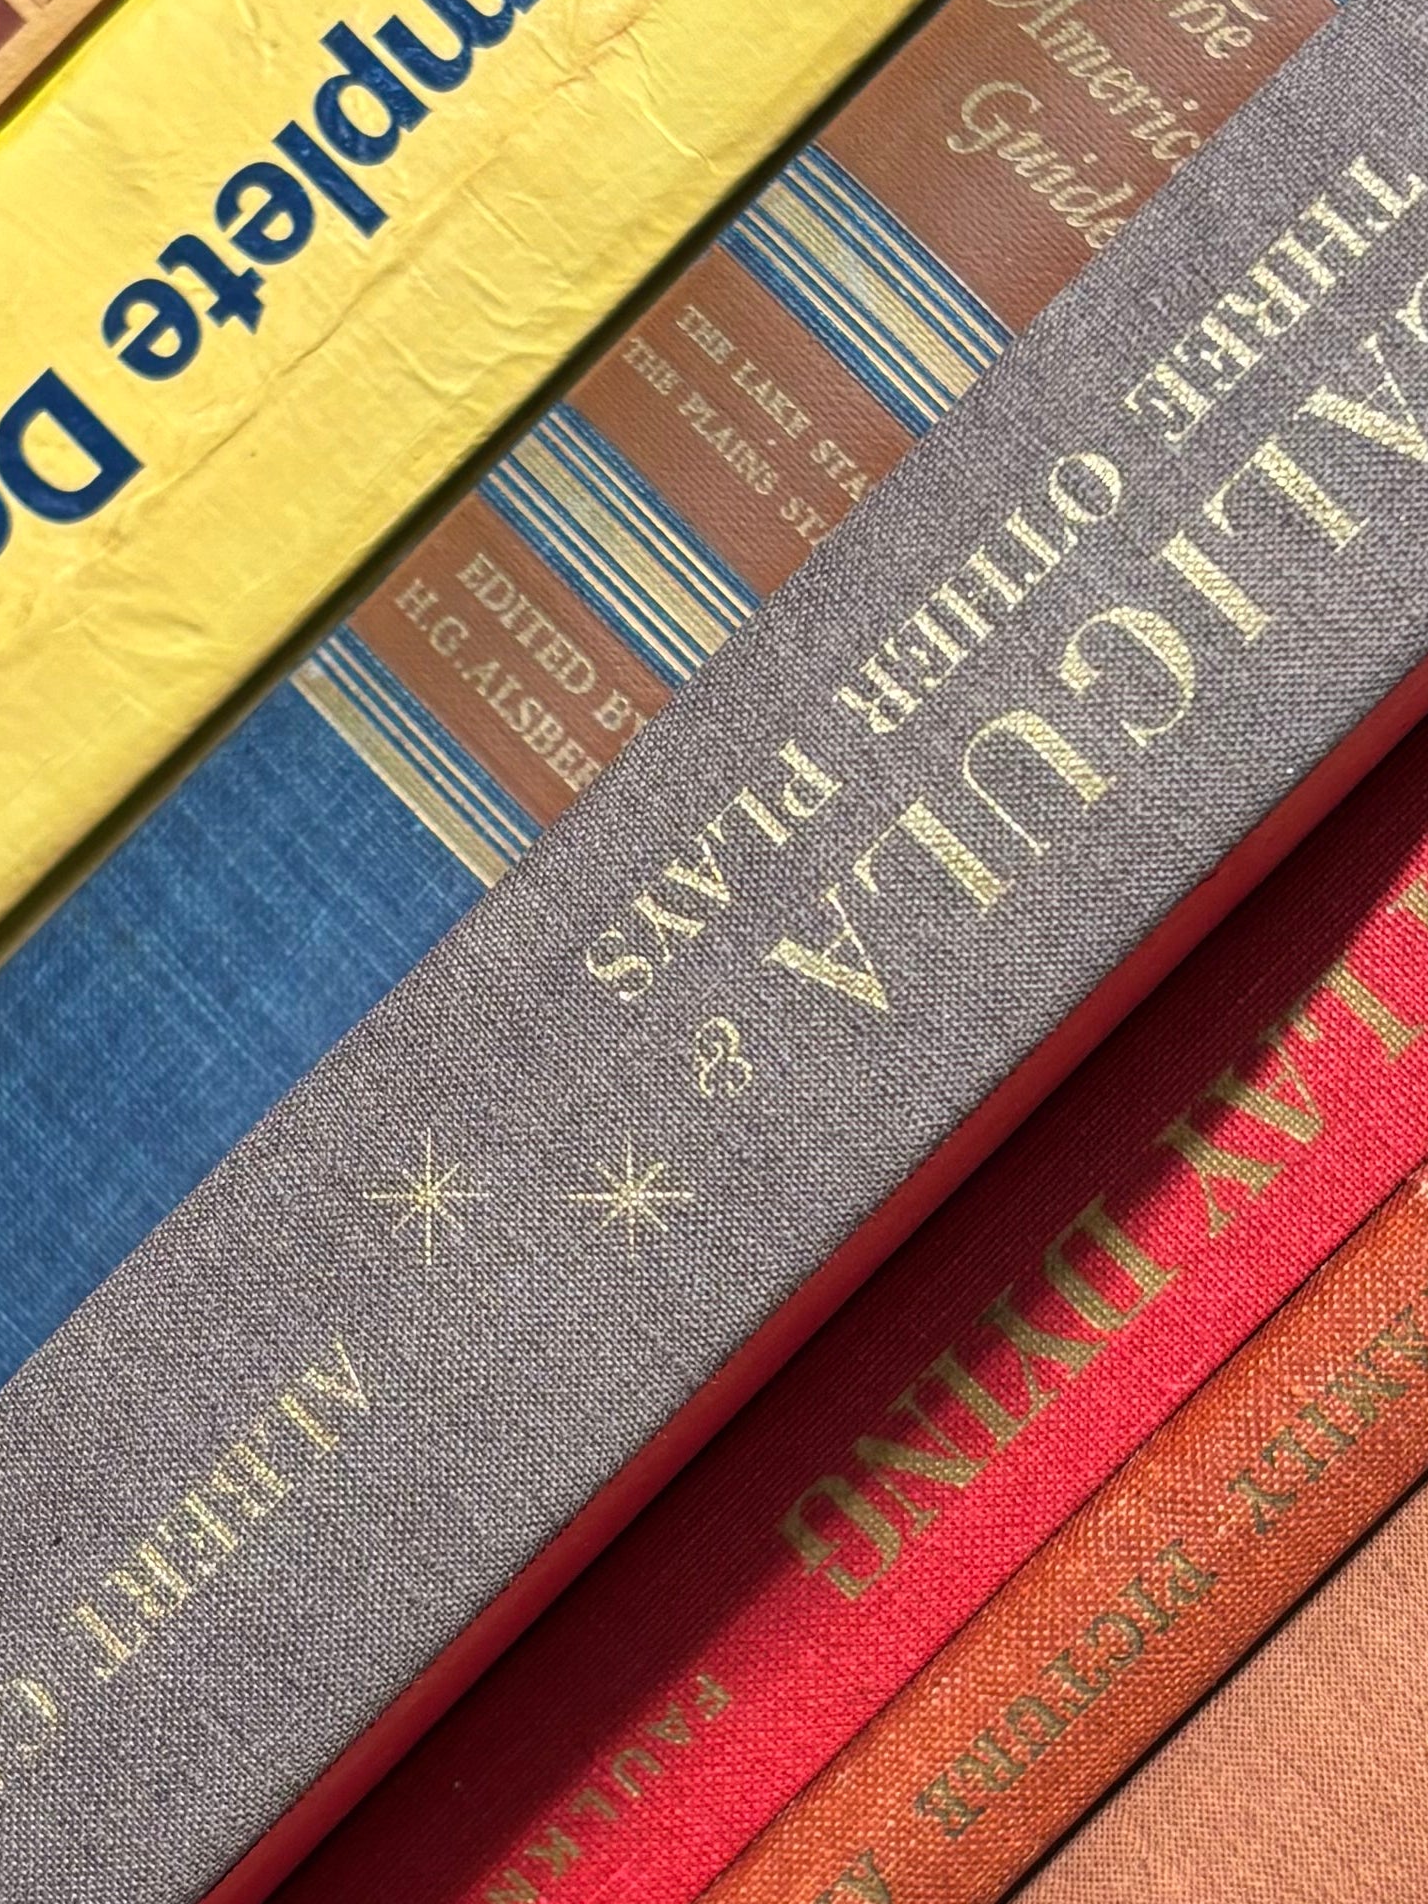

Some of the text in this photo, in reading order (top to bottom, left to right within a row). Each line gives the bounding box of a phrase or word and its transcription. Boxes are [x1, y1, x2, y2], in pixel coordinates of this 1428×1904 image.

[946, 80, 1135, 250] Guide
[620, 336, 682, 398] THE
[676, 394, 781, 497] PLAINS
[676, 302, 736, 365] THE
[731, 357, 814, 440] LAKE
[456, 552, 599, 698] EDITED
[834, 450, 1124, 736] OTHER
[584, 738, 842, 1000] PLAYS
[691, 1015, 754, 1097] &
[1155, 961, 1427, 1239] LAY
[67, 1338, 370, 1678] ALBERT
[779, 1193, 1184, 1602] DYING
[914, 1538, 1218, 1841] PICTURE
